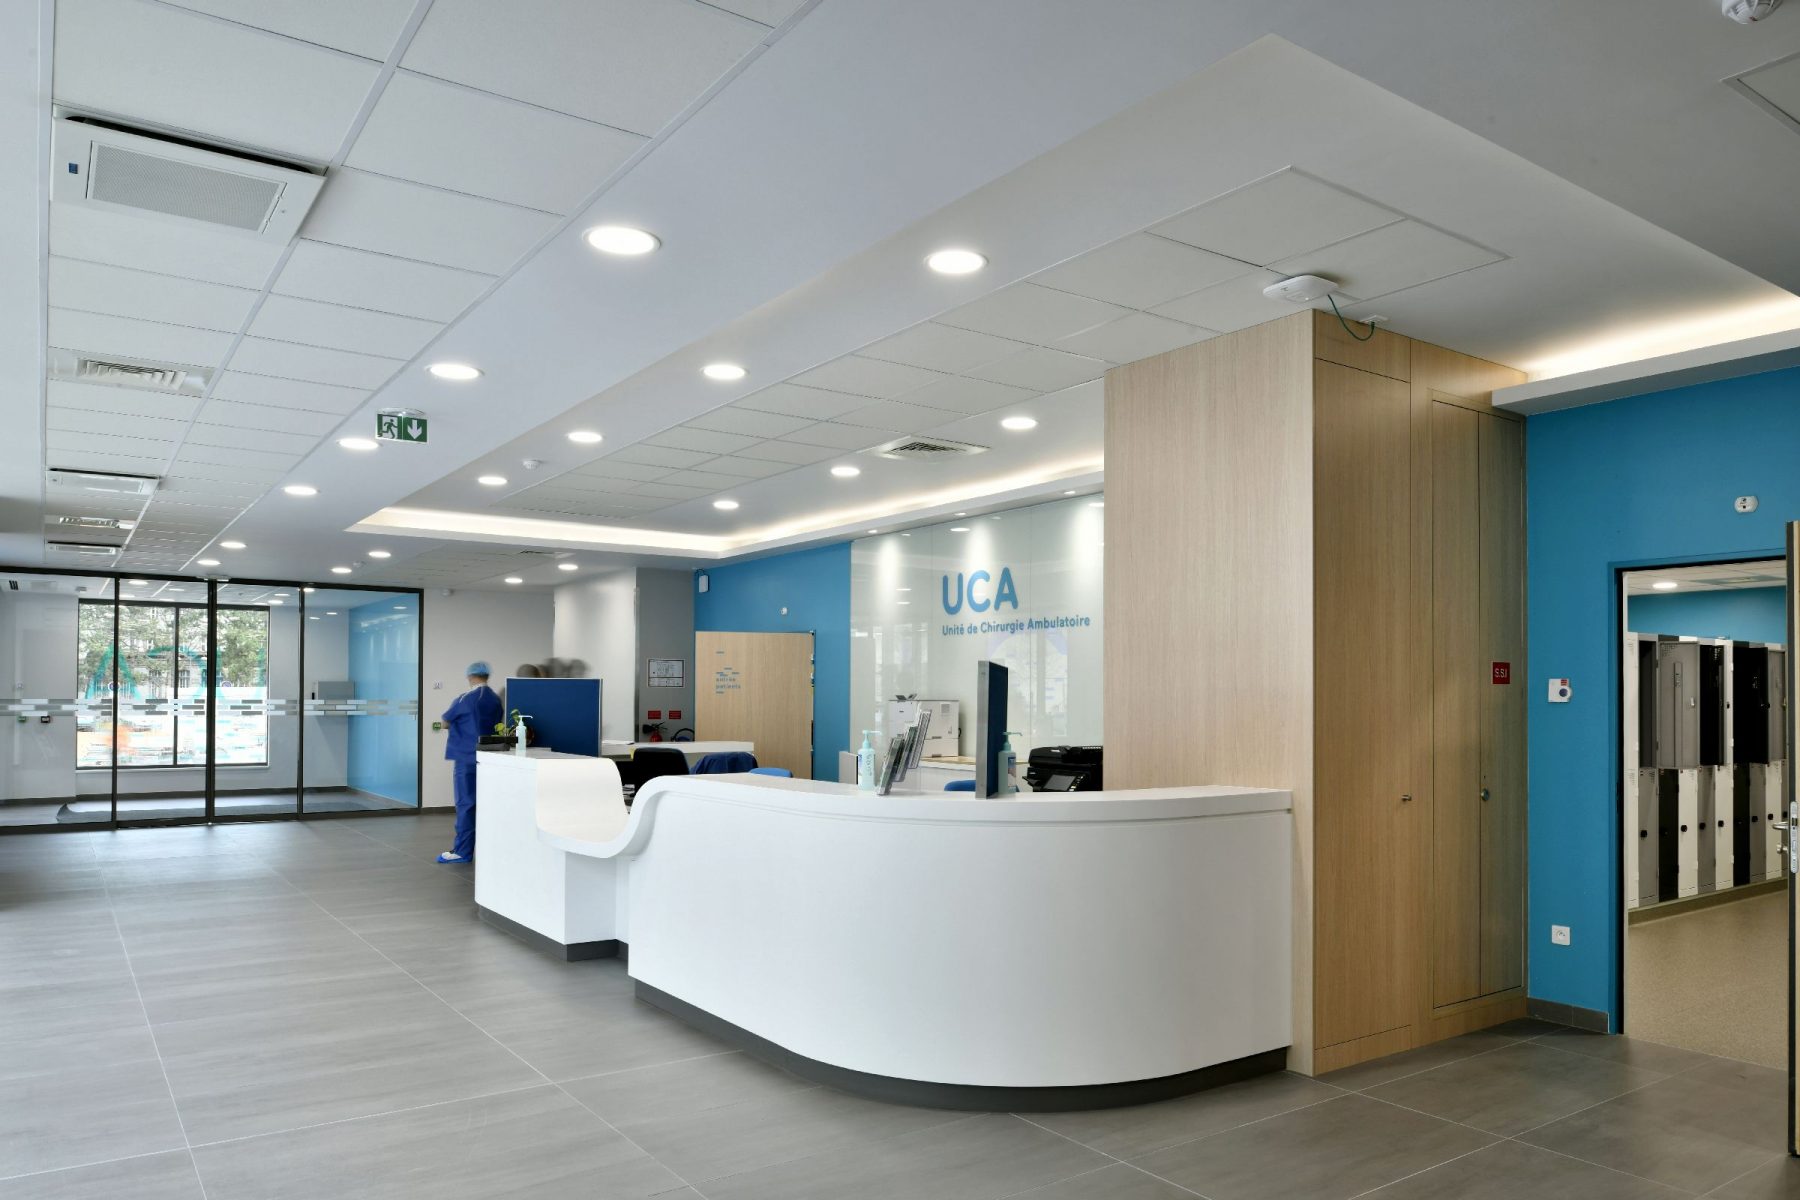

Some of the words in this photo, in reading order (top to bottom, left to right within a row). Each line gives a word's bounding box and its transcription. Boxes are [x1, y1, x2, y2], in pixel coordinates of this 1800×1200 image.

[942, 567, 1019, 615] UCA
[942, 624, 965, 636] Unité
[967, 624, 978, 634] de
[980, 619, 1025, 634] Chirurgie
[1027, 615, 1090, 630] Ambulatoire
